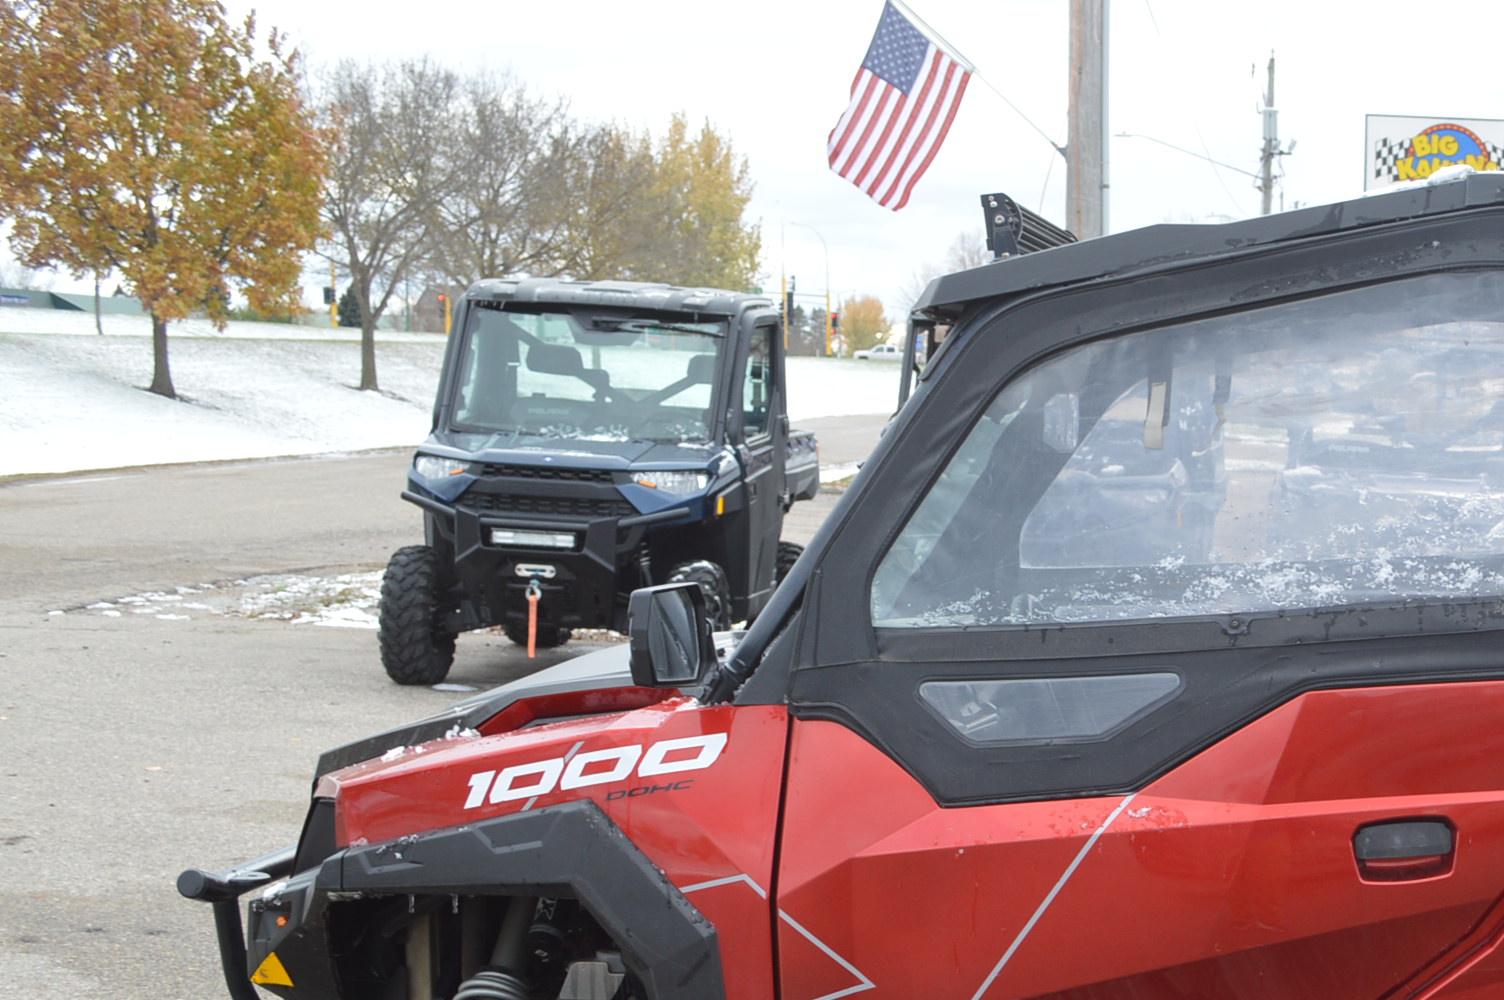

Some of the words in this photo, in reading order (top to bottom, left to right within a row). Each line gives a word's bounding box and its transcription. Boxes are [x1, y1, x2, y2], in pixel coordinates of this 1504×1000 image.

[1412, 134, 1459, 157] BIG
[463, 732, 728, 810] 1000
[605, 779, 694, 802] DOHC
